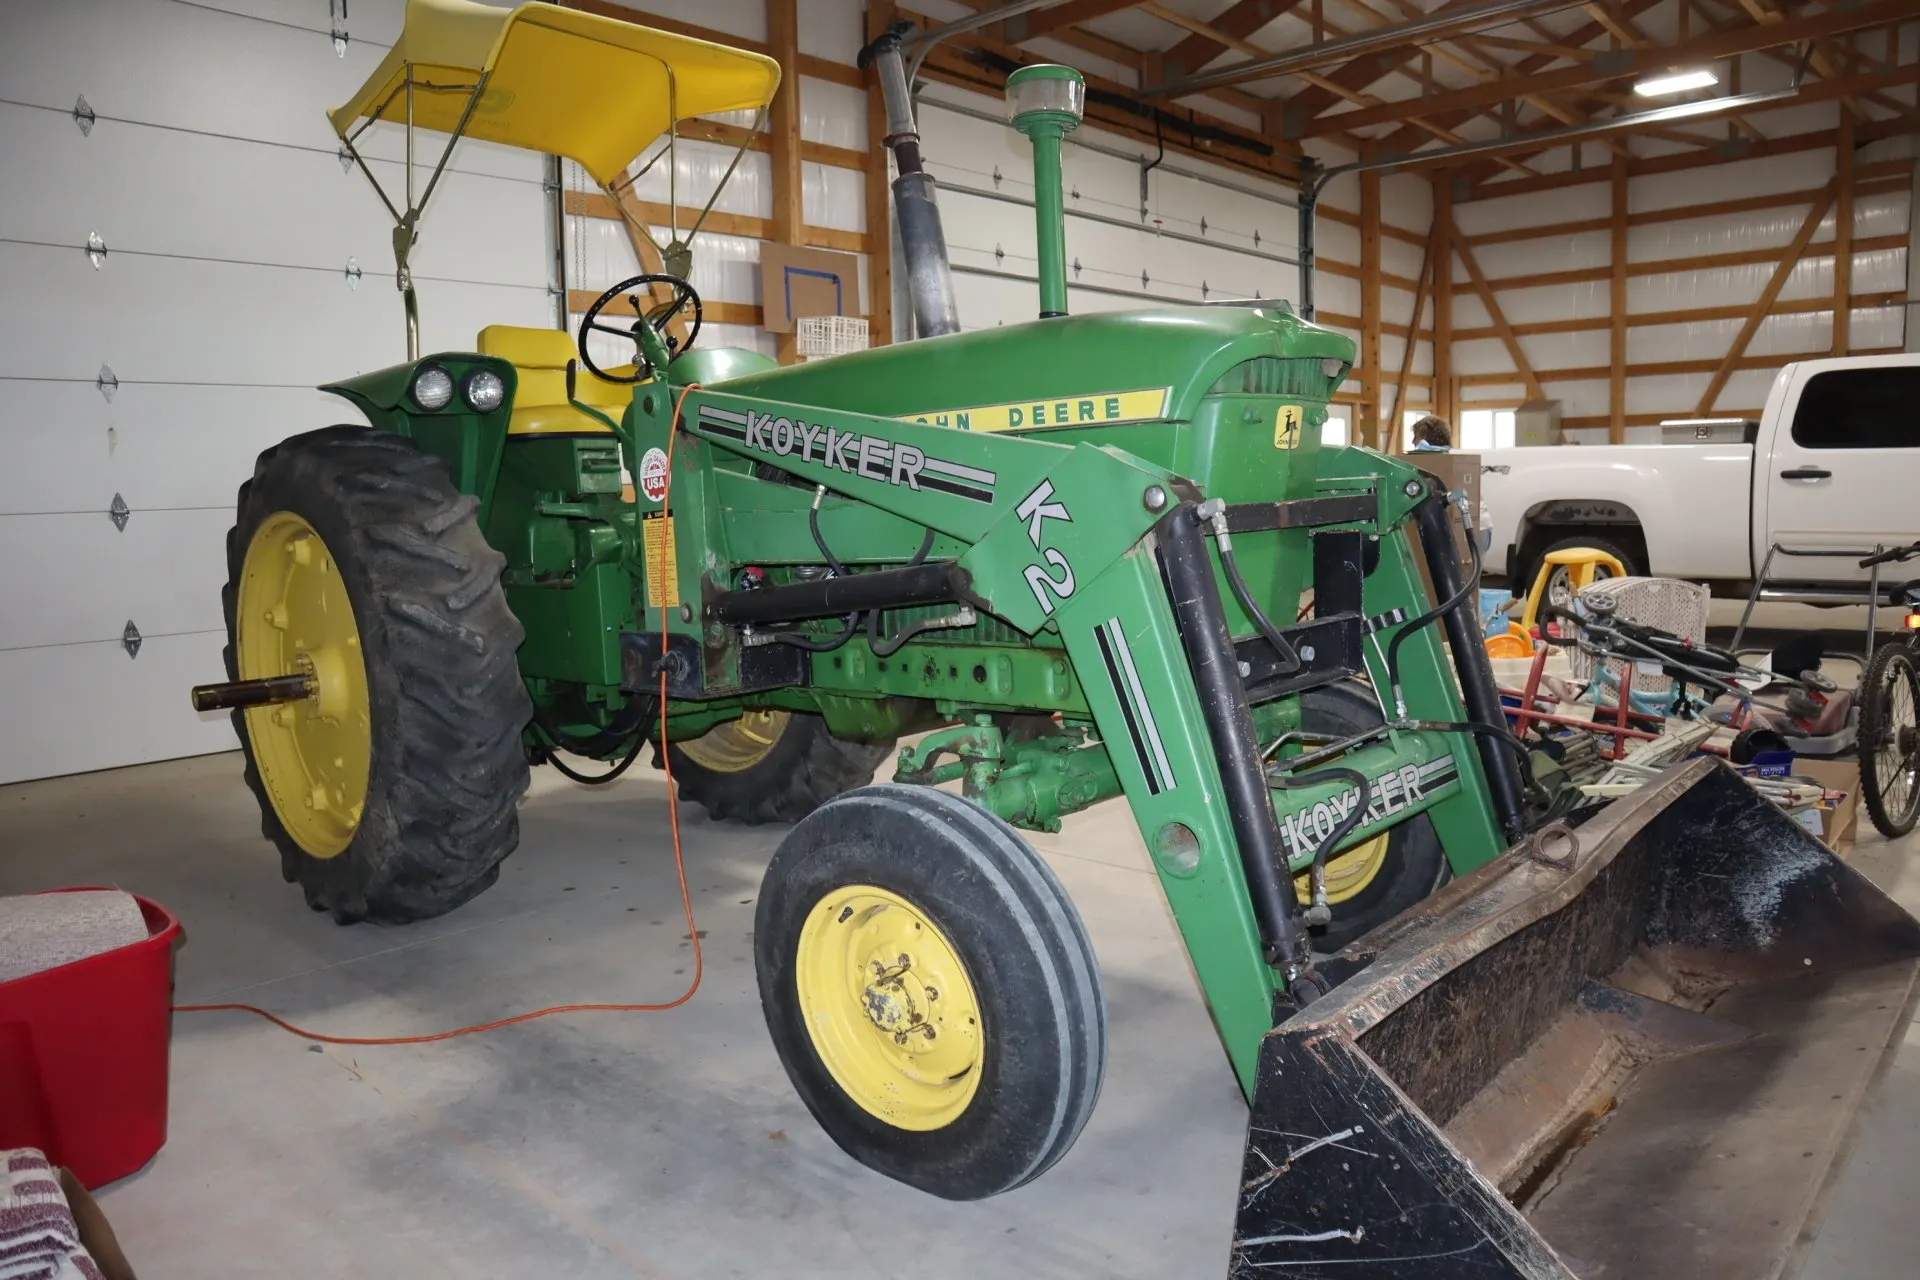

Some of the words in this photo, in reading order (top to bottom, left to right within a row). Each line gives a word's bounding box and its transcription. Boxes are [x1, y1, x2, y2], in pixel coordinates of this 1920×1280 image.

[1008, 397, 1121, 428] DEERE
[744, 409, 926, 492] KOYKER
[653, 455, 666, 473] DAKOTA
[647, 477, 665, 490] USA
